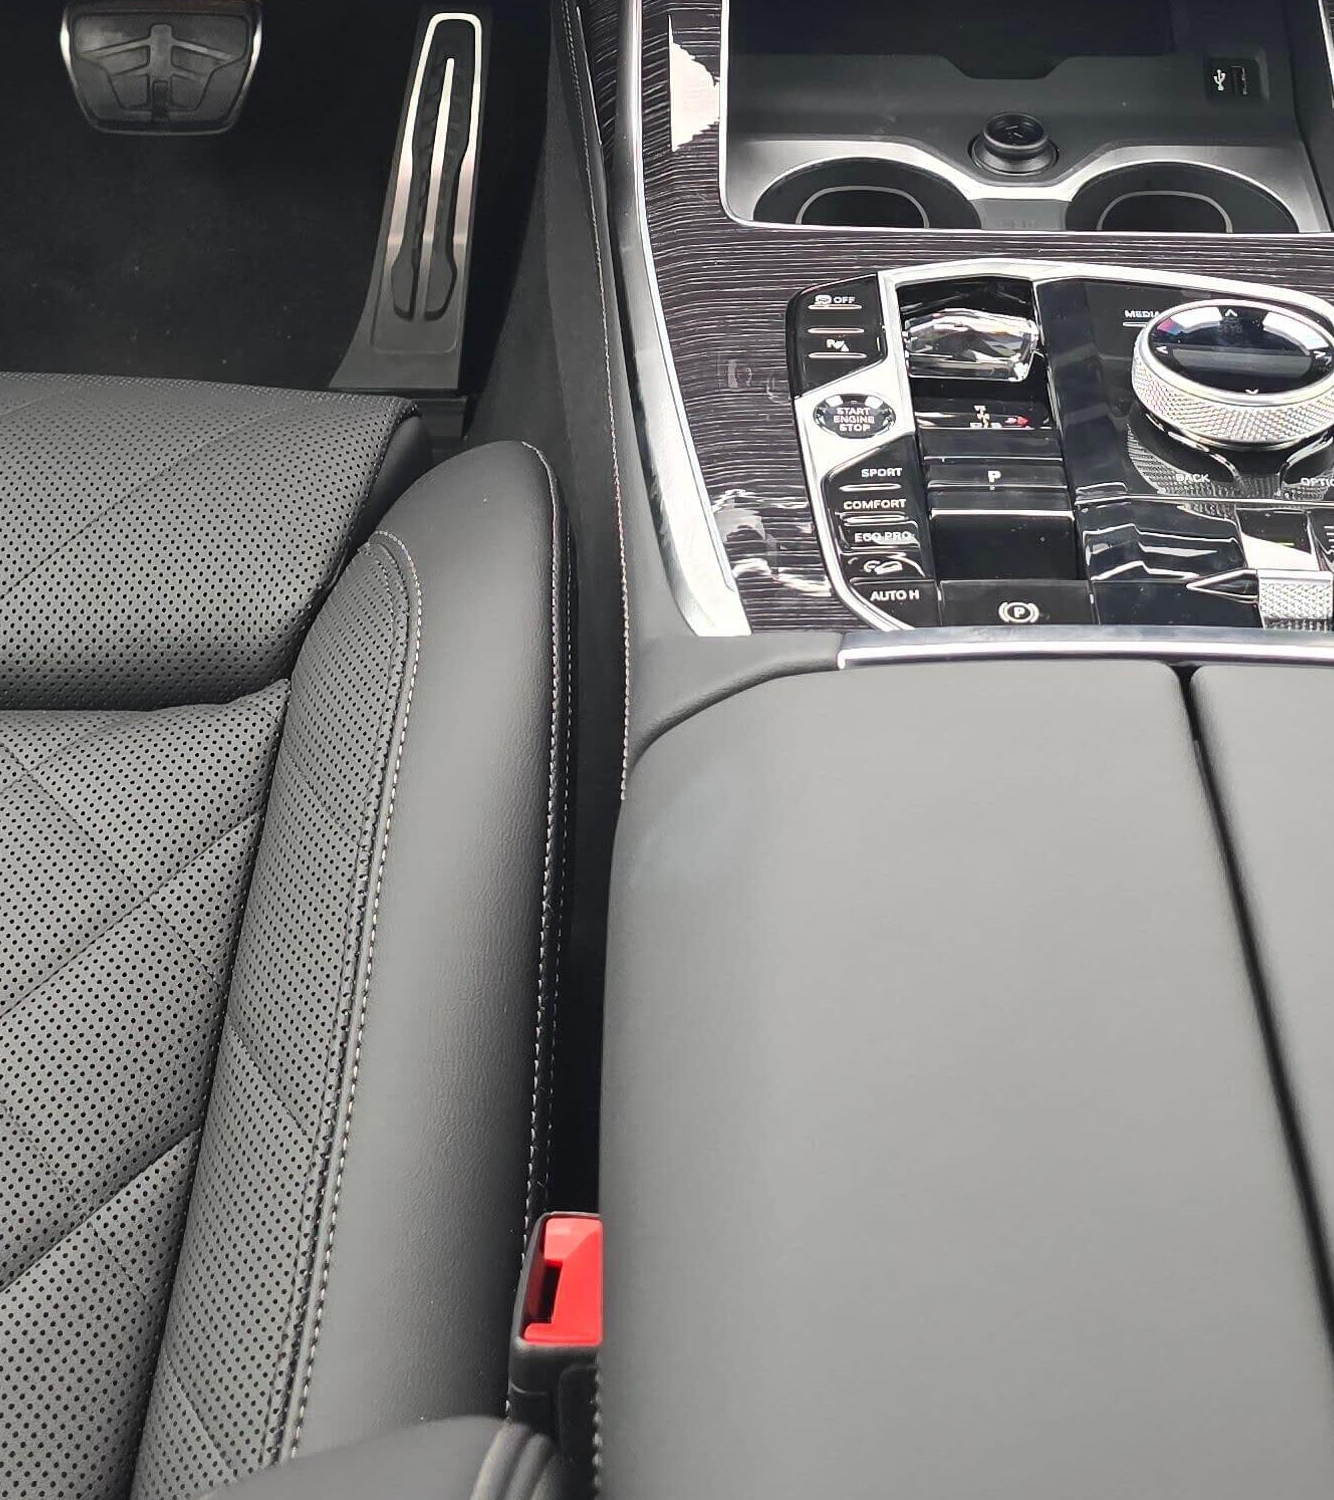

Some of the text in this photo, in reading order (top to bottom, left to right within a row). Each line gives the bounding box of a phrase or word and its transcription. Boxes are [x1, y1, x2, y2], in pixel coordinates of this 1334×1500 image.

[833, 296, 856, 304] OFF
[836, 407, 871, 415] START
[833, 415, 875, 424] ENGINE
[839, 423, 871, 431] STOP
[861, 467, 903, 478] SPORT
[988, 470, 1002, 483] P
[1175, 473, 1211, 483] BACK
[843, 499, 907, 510] COMFORT
[854, 531, 912, 543] ECO PRO
[870, 589, 920, 601] AUTO H
